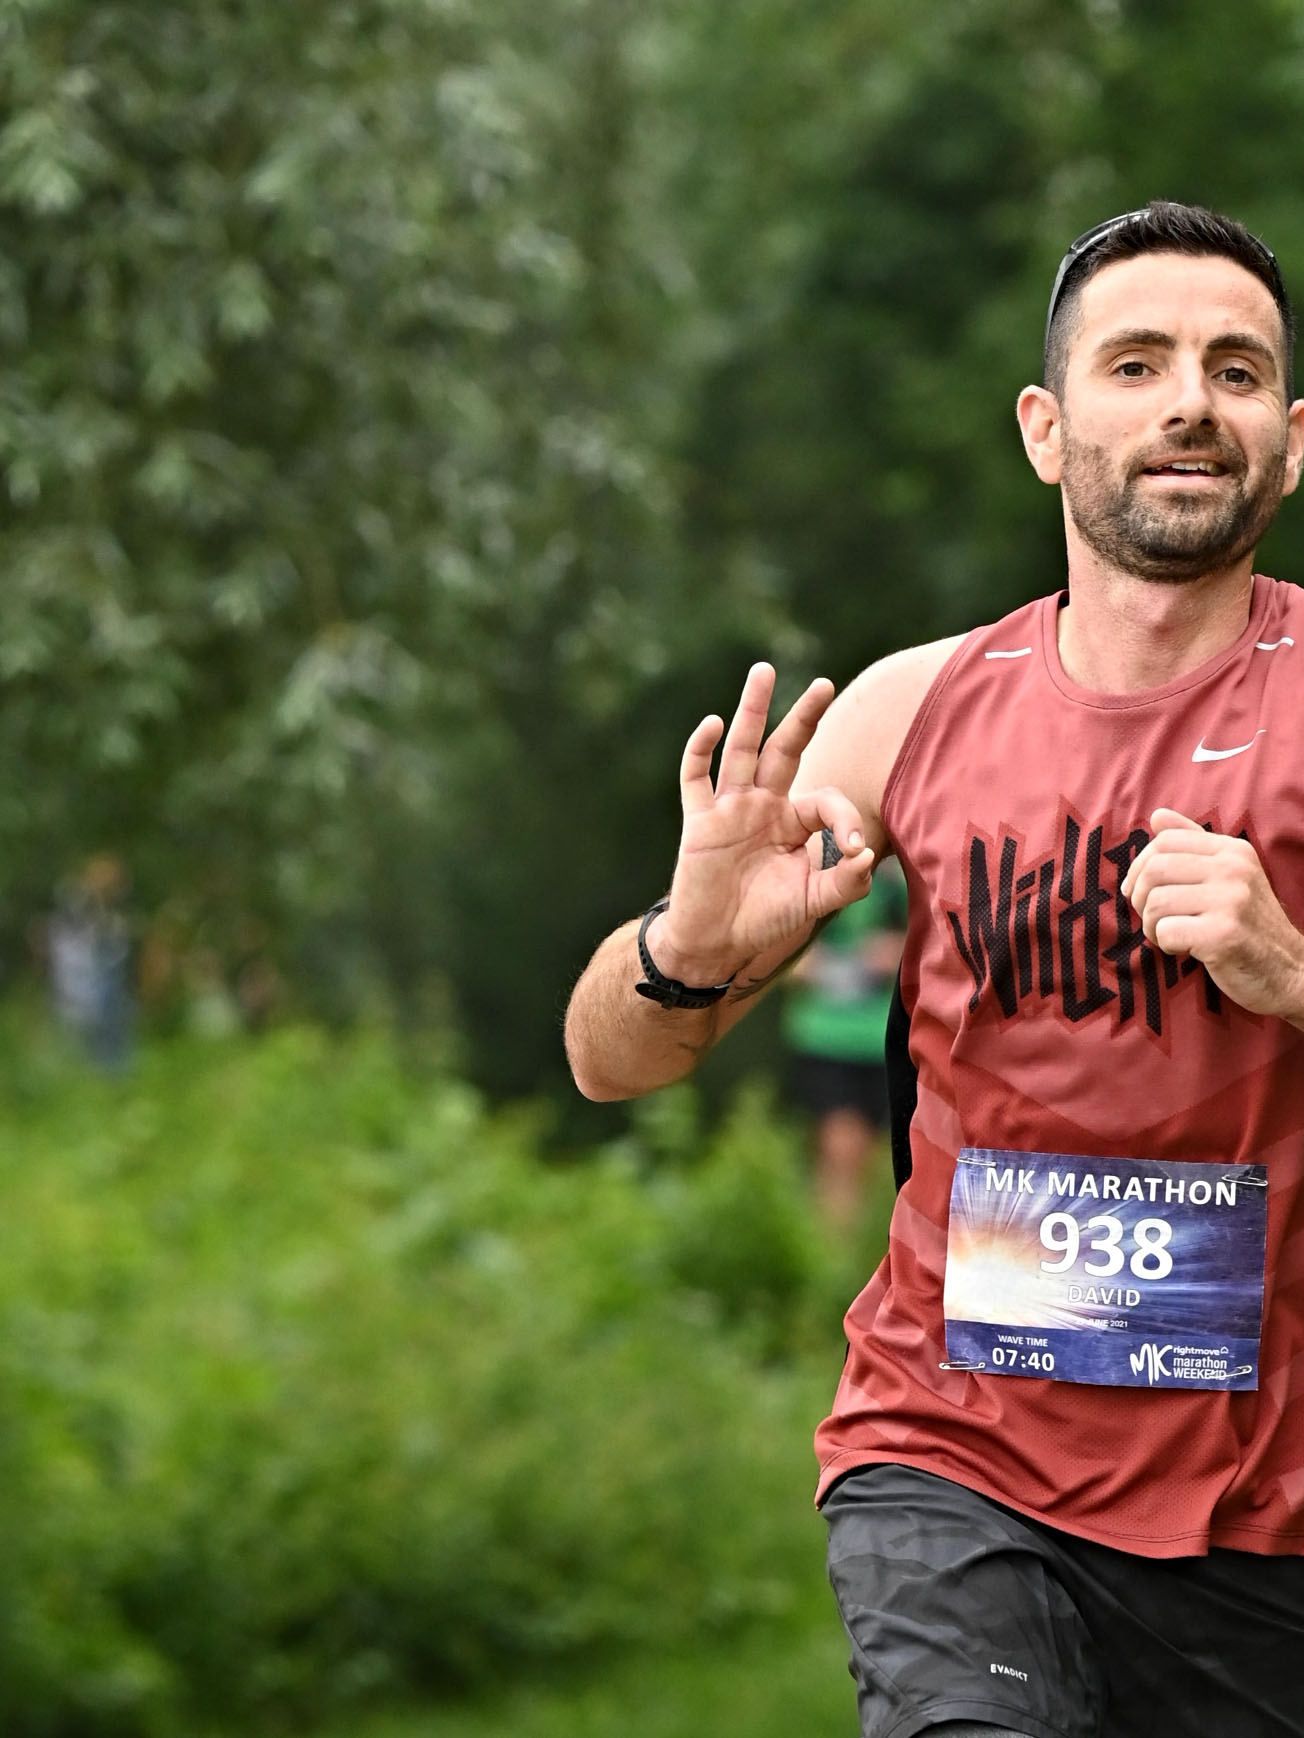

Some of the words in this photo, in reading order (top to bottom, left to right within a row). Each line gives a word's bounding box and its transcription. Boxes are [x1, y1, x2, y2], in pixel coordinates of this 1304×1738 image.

[985, 1167, 1035, 1195] MK
[1048, 1172, 1237, 1206] MARATHON
[1039, 1212, 1173, 1280] 938
[1067, 1285, 1141, 1307] DAVID
[1110, 1319, 1128, 1328] 2021
[997, 1334, 1024, 1345] WAVE
[1025, 1337, 1049, 1347] TIME
[1173, 1345, 1220, 1356] rightmove
[992, 1347, 1055, 1372] 07:40
[1129, 1343, 1173, 1386] MK
[1173, 1356, 1228, 1369] marathon
[990, 1663, 1028, 1682] EVADICT
